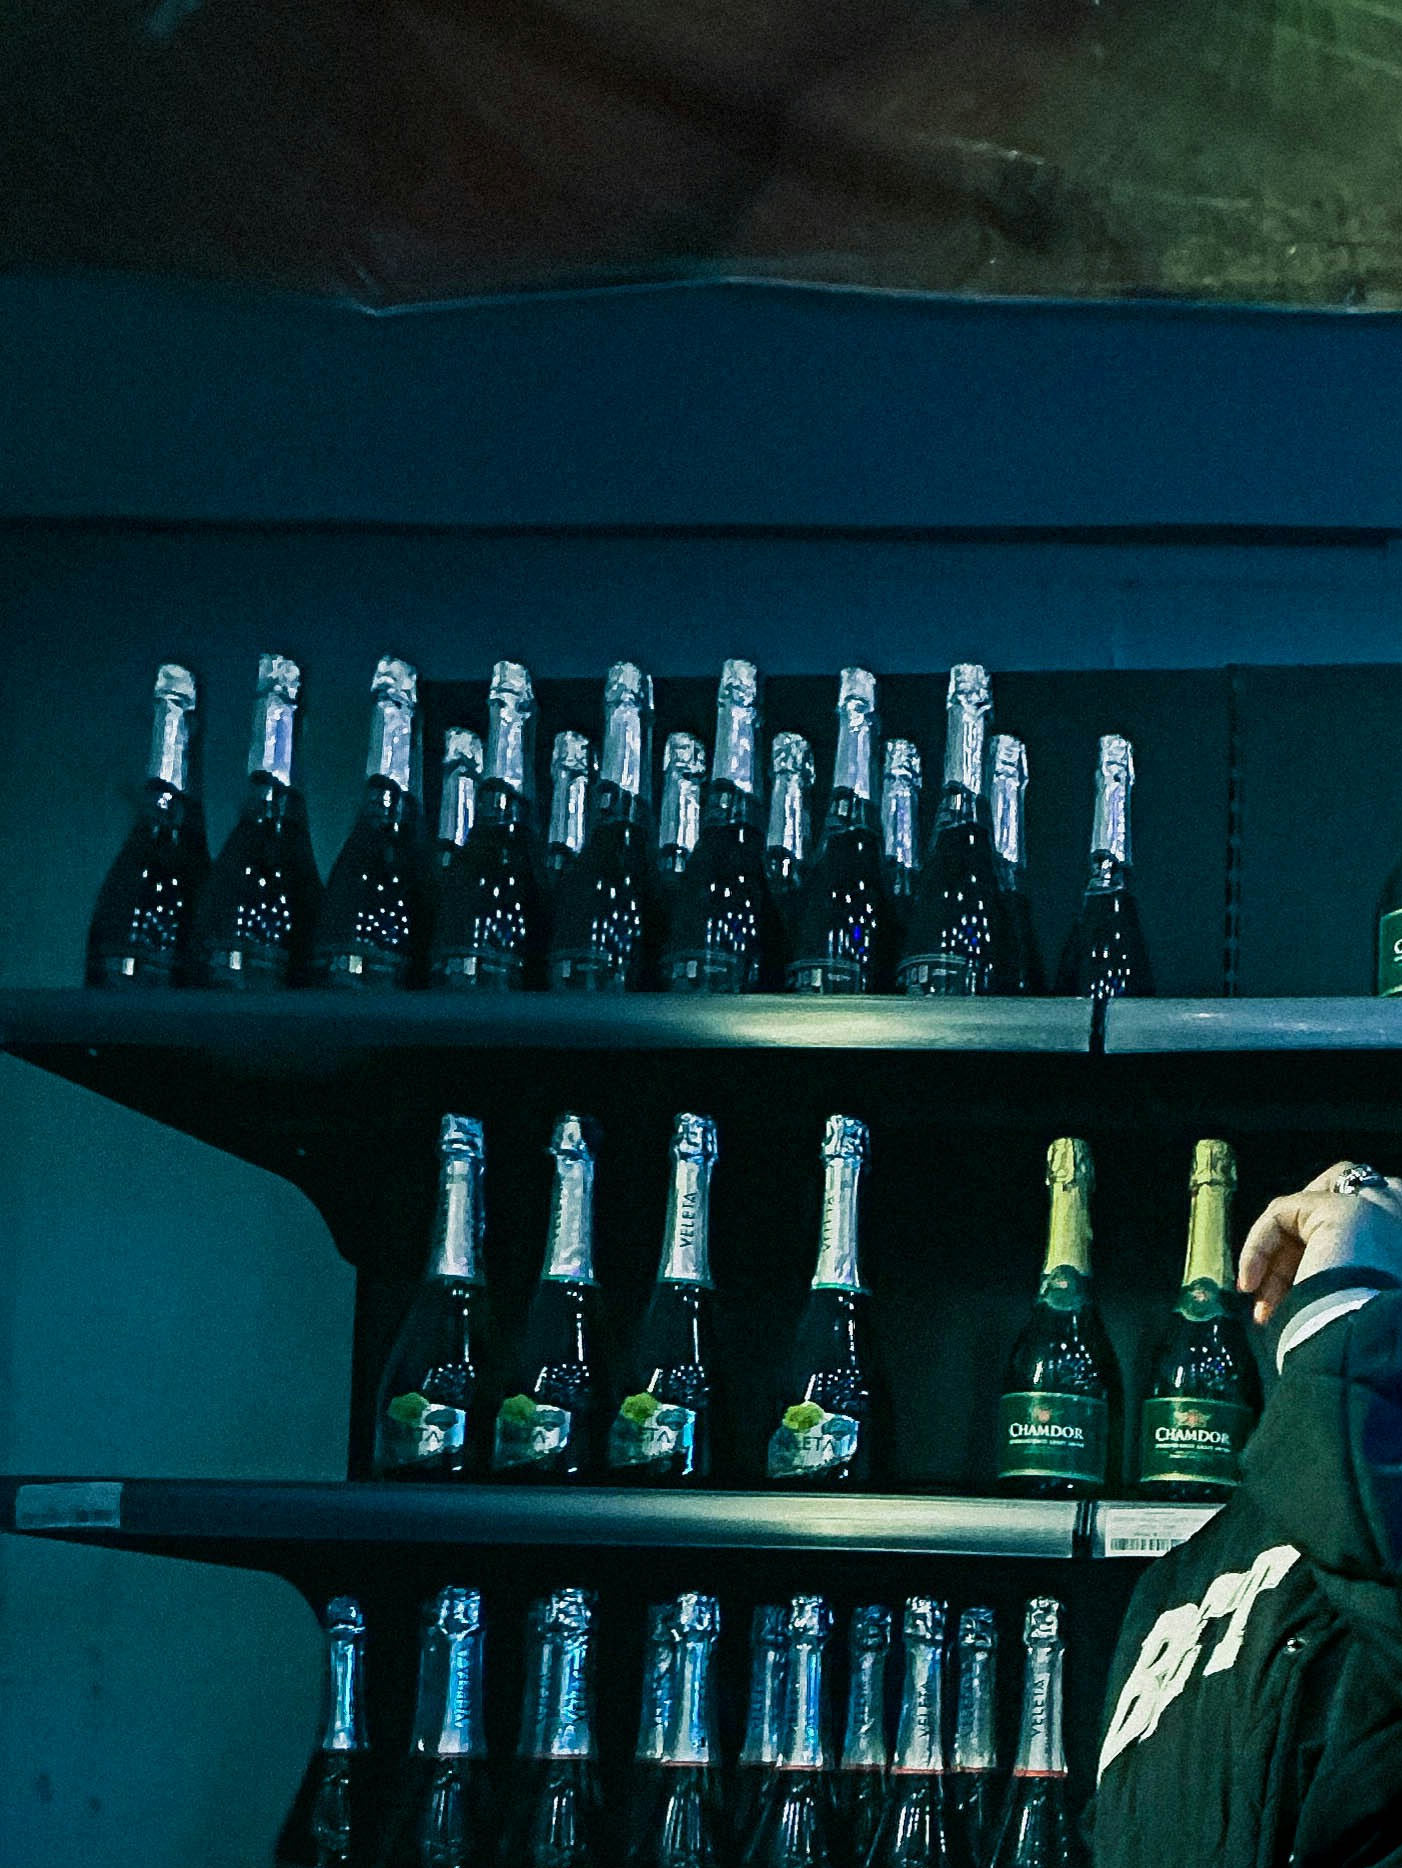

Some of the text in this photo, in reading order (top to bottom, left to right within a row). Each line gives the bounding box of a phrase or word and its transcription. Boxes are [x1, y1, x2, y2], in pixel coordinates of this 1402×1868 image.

[679, 1192, 698, 1248] VELETA
[1009, 1422, 1085, 1440] CHAMDOR
[1154, 1426, 1232, 1444] CHAMDOR
